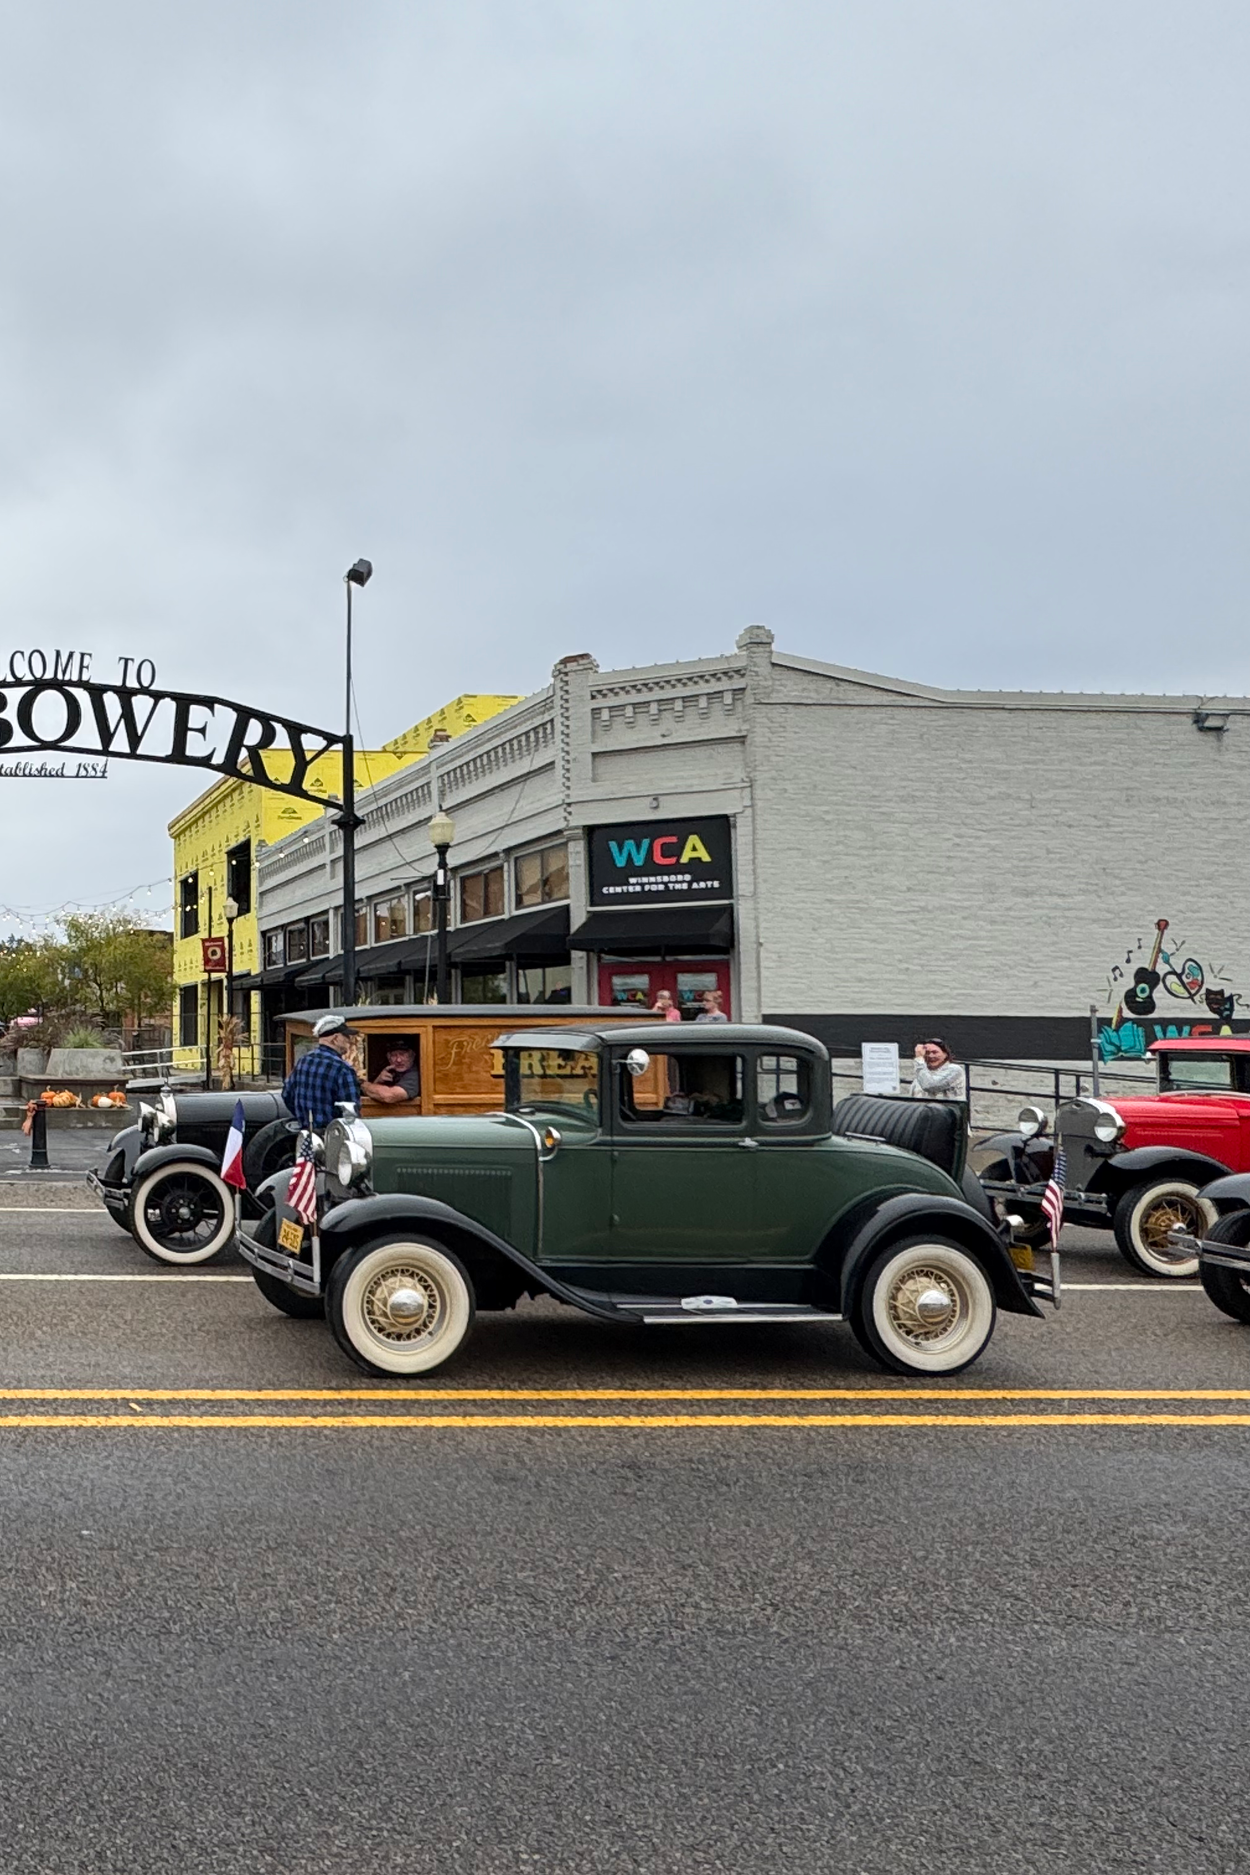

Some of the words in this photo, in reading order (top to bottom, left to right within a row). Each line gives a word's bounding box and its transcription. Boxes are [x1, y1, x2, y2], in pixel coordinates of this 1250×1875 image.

[118, 657, 156, 690] TO
[75, 759, 108, 777] 1884
[608, 834, 712, 868] WCA
[602, 885, 642, 894] CENTER
[644, 883, 666, 891] FOR
[668, 882, 688, 890] THE
[691, 880, 720, 889] ARTS
[628, 874, 692, 884] WINNSBORO
[682, 990, 705, 1001] WC
